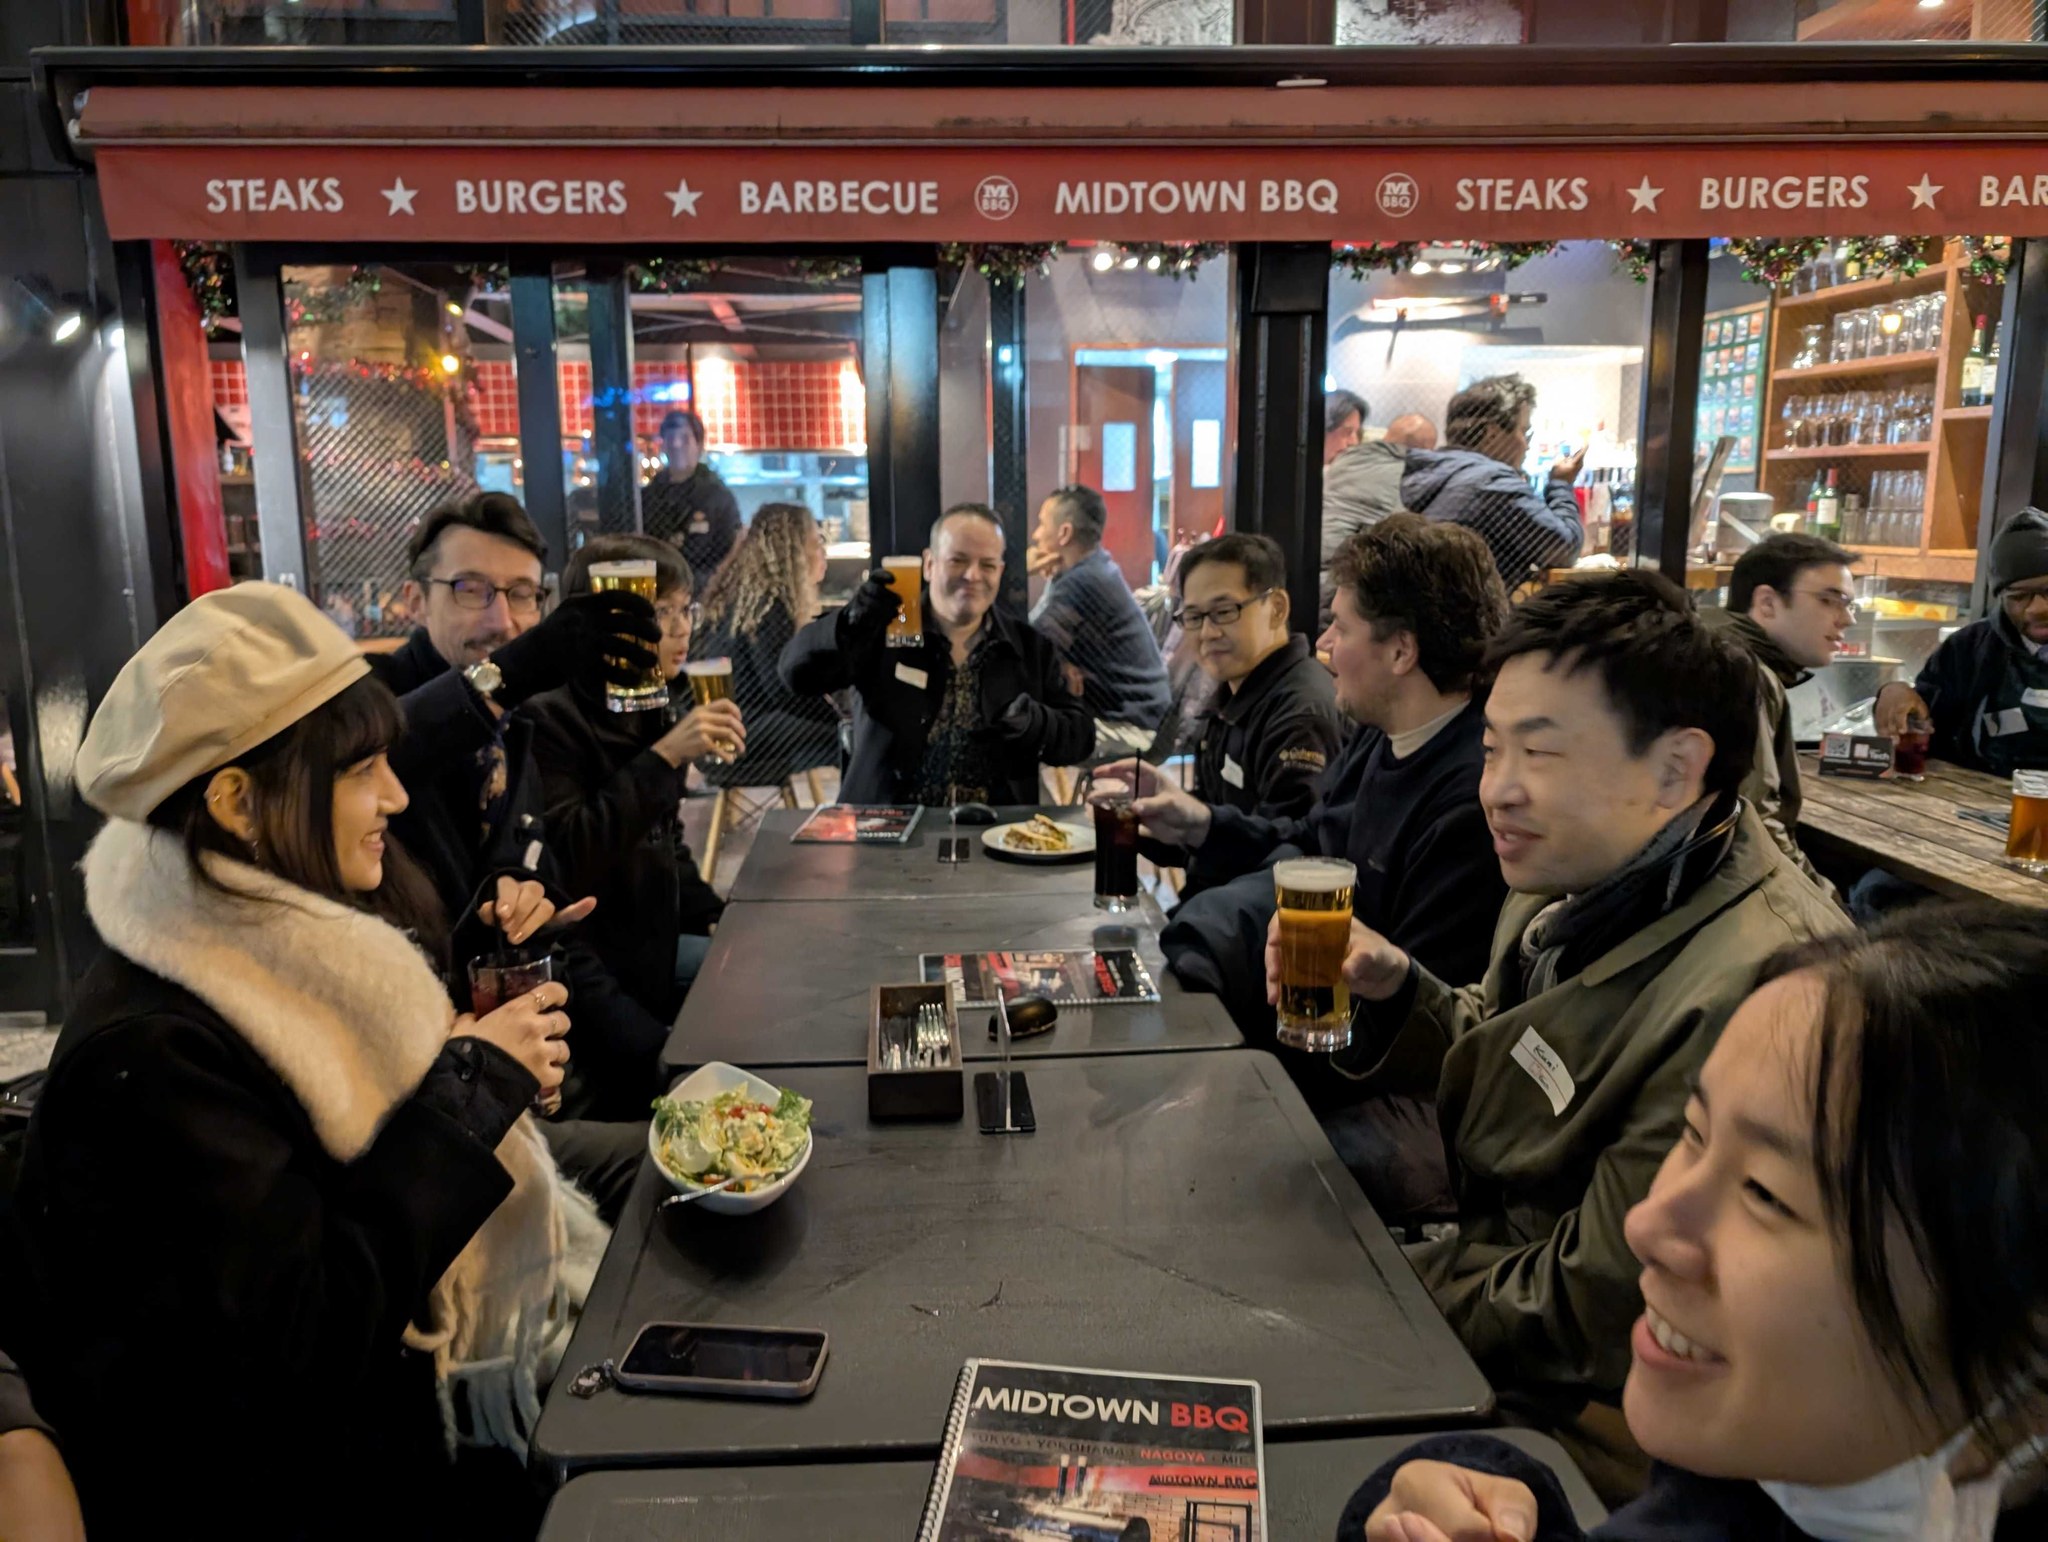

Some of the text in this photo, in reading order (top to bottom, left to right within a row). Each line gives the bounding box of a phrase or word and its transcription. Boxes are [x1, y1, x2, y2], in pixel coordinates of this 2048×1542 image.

[206, 174, 2048, 215] STEAKS BURGERS BARBECUE MIDTOWN BBQ STEAKS BURGERS BAR
[982, 184, 1010, 198] M
[1384, 182, 1411, 195] M
[982, 198, 1011, 212] BBQ
[1382, 195, 1411, 209] BBQ
[975, 1386, 1249, 1434] MIDTOWN BBQ
[1036, 1438, 1125, 1458] YOKOHAMA
[1140, 1448, 1205, 1464] NAGOYA
[1148, 1474, 1218, 1488] MIDTOWN
